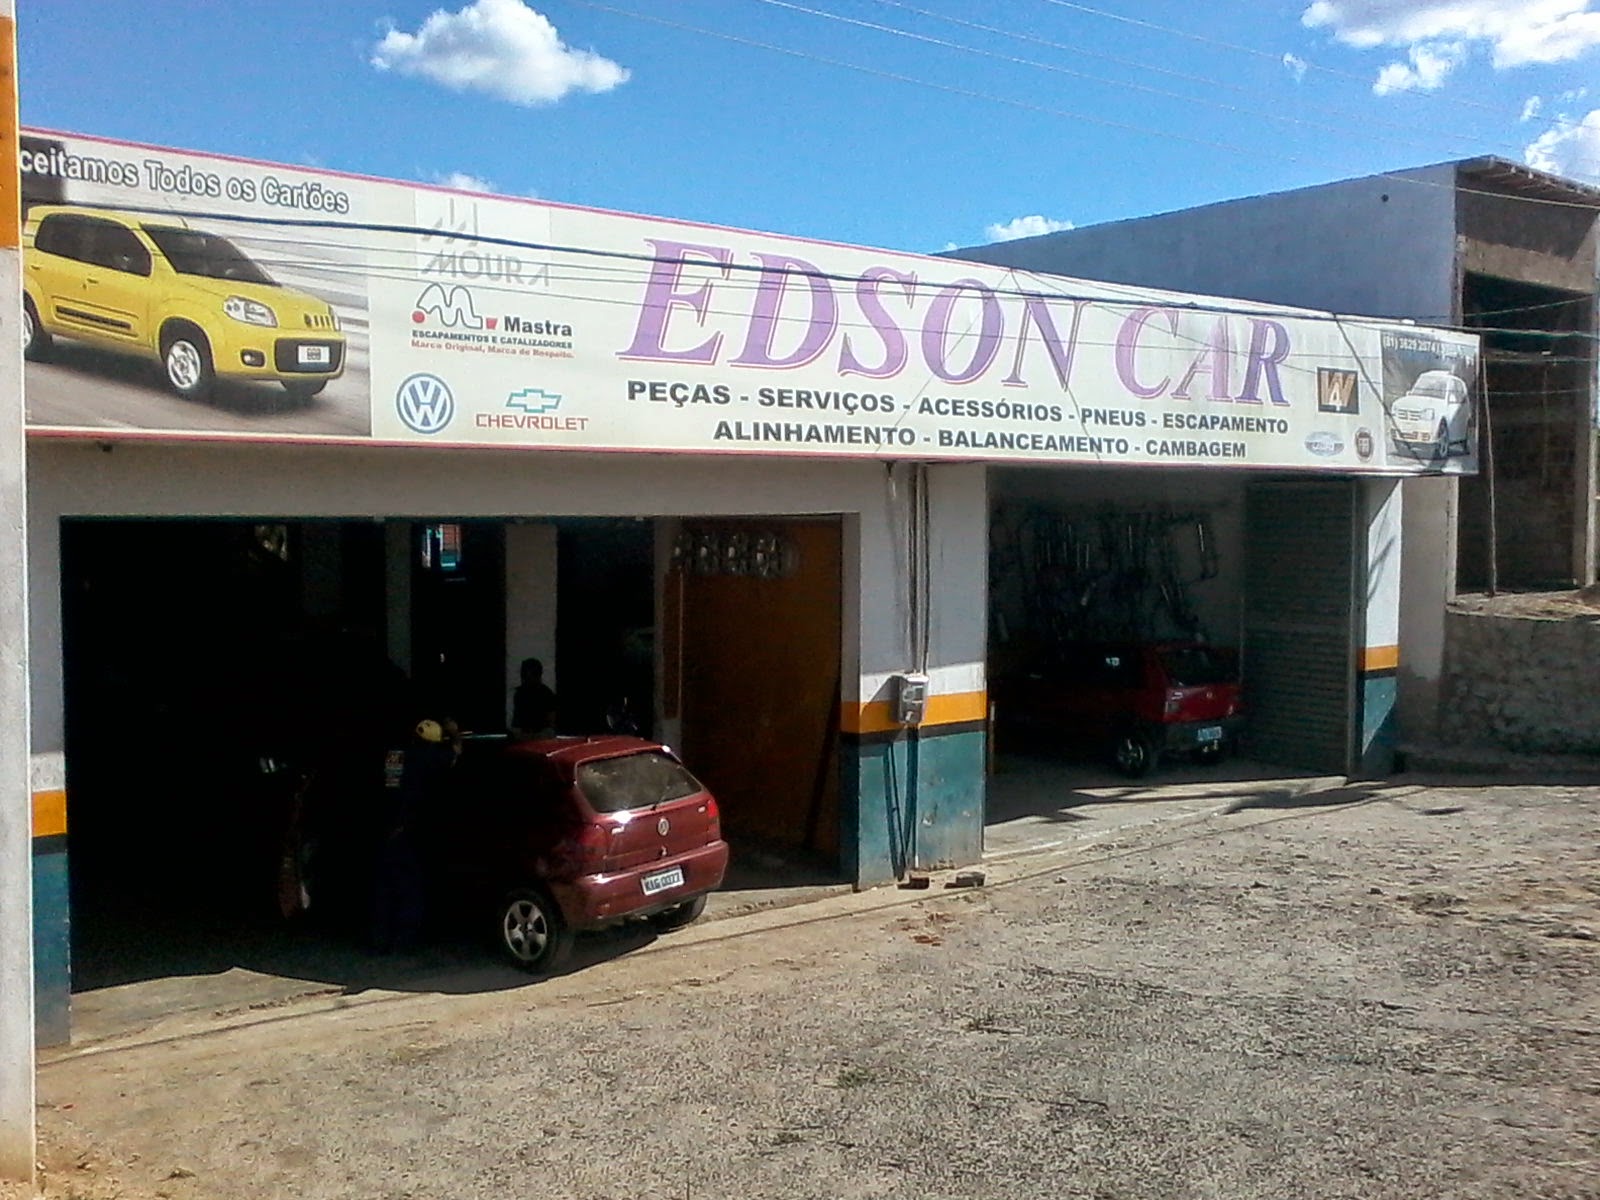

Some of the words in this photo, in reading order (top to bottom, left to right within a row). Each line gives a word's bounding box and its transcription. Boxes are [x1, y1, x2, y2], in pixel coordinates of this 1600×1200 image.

[20, 147, 140, 187] ceitamos
[144, 160, 220, 197] Todos
[225, 175, 256, 201] os
[260, 176, 349, 214] Cartões
[421, 249, 551, 287] MOURA
[412, 329, 489, 343] ESCAPAMENTOS
[500, 336, 573, 349] CATALIZADORES
[504, 316, 573, 337] Mastra
[615, 238, 1092, 391] EDSON
[1113, 306, 1292, 407] CAR
[475, 413, 589, 431] CHEVROLET
[627, 380, 731, 408] PEÇAS
[757, 387, 896, 416] SERVIÇOS
[917, 397, 1063, 423] ACESSÓRIOS
[1080, 406, 1147, 428] PNEUS
[1162, 412, 1289, 434] ESCAPAMENTO
[713, 420, 916, 447] ALINHAMENTO
[938, 428, 1129, 455] BALANCEAMENTO
[1146, 439, 1247, 459] CAMBAGEM
